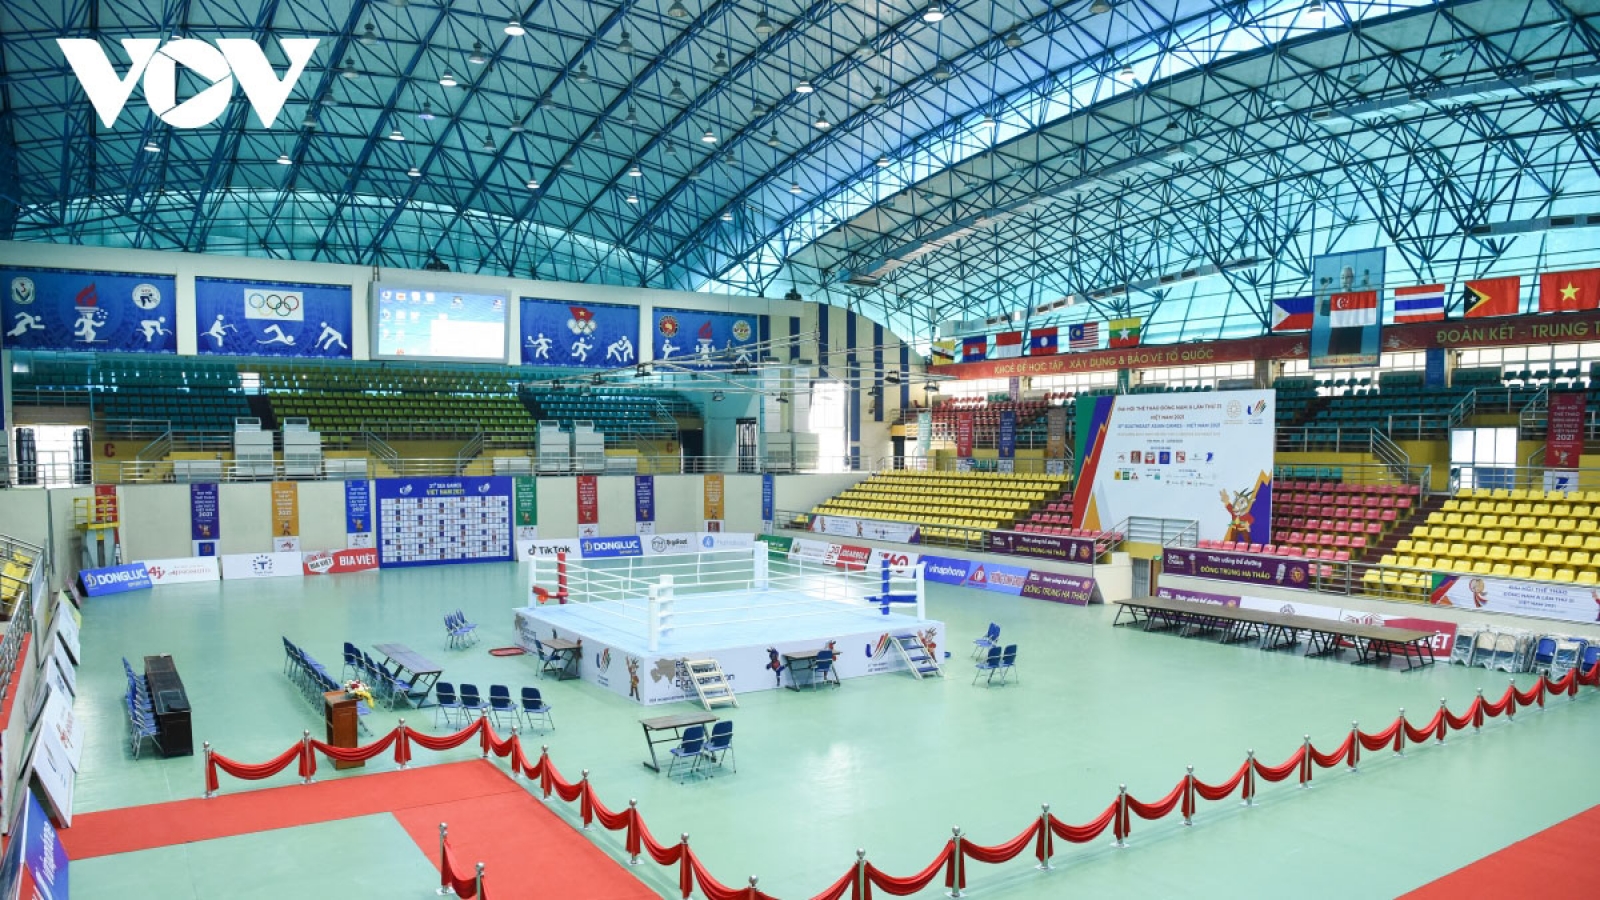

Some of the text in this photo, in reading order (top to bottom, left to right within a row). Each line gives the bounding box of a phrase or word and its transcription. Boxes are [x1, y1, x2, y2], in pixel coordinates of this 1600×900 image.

[1436, 325, 1484, 343] ĐOÀN
[1531, 321, 1588, 338] TRUNG
[539, 545, 572, 554] TikTok
[339, 556, 356, 566] BIA
[928, 564, 966, 578] vinaphone
